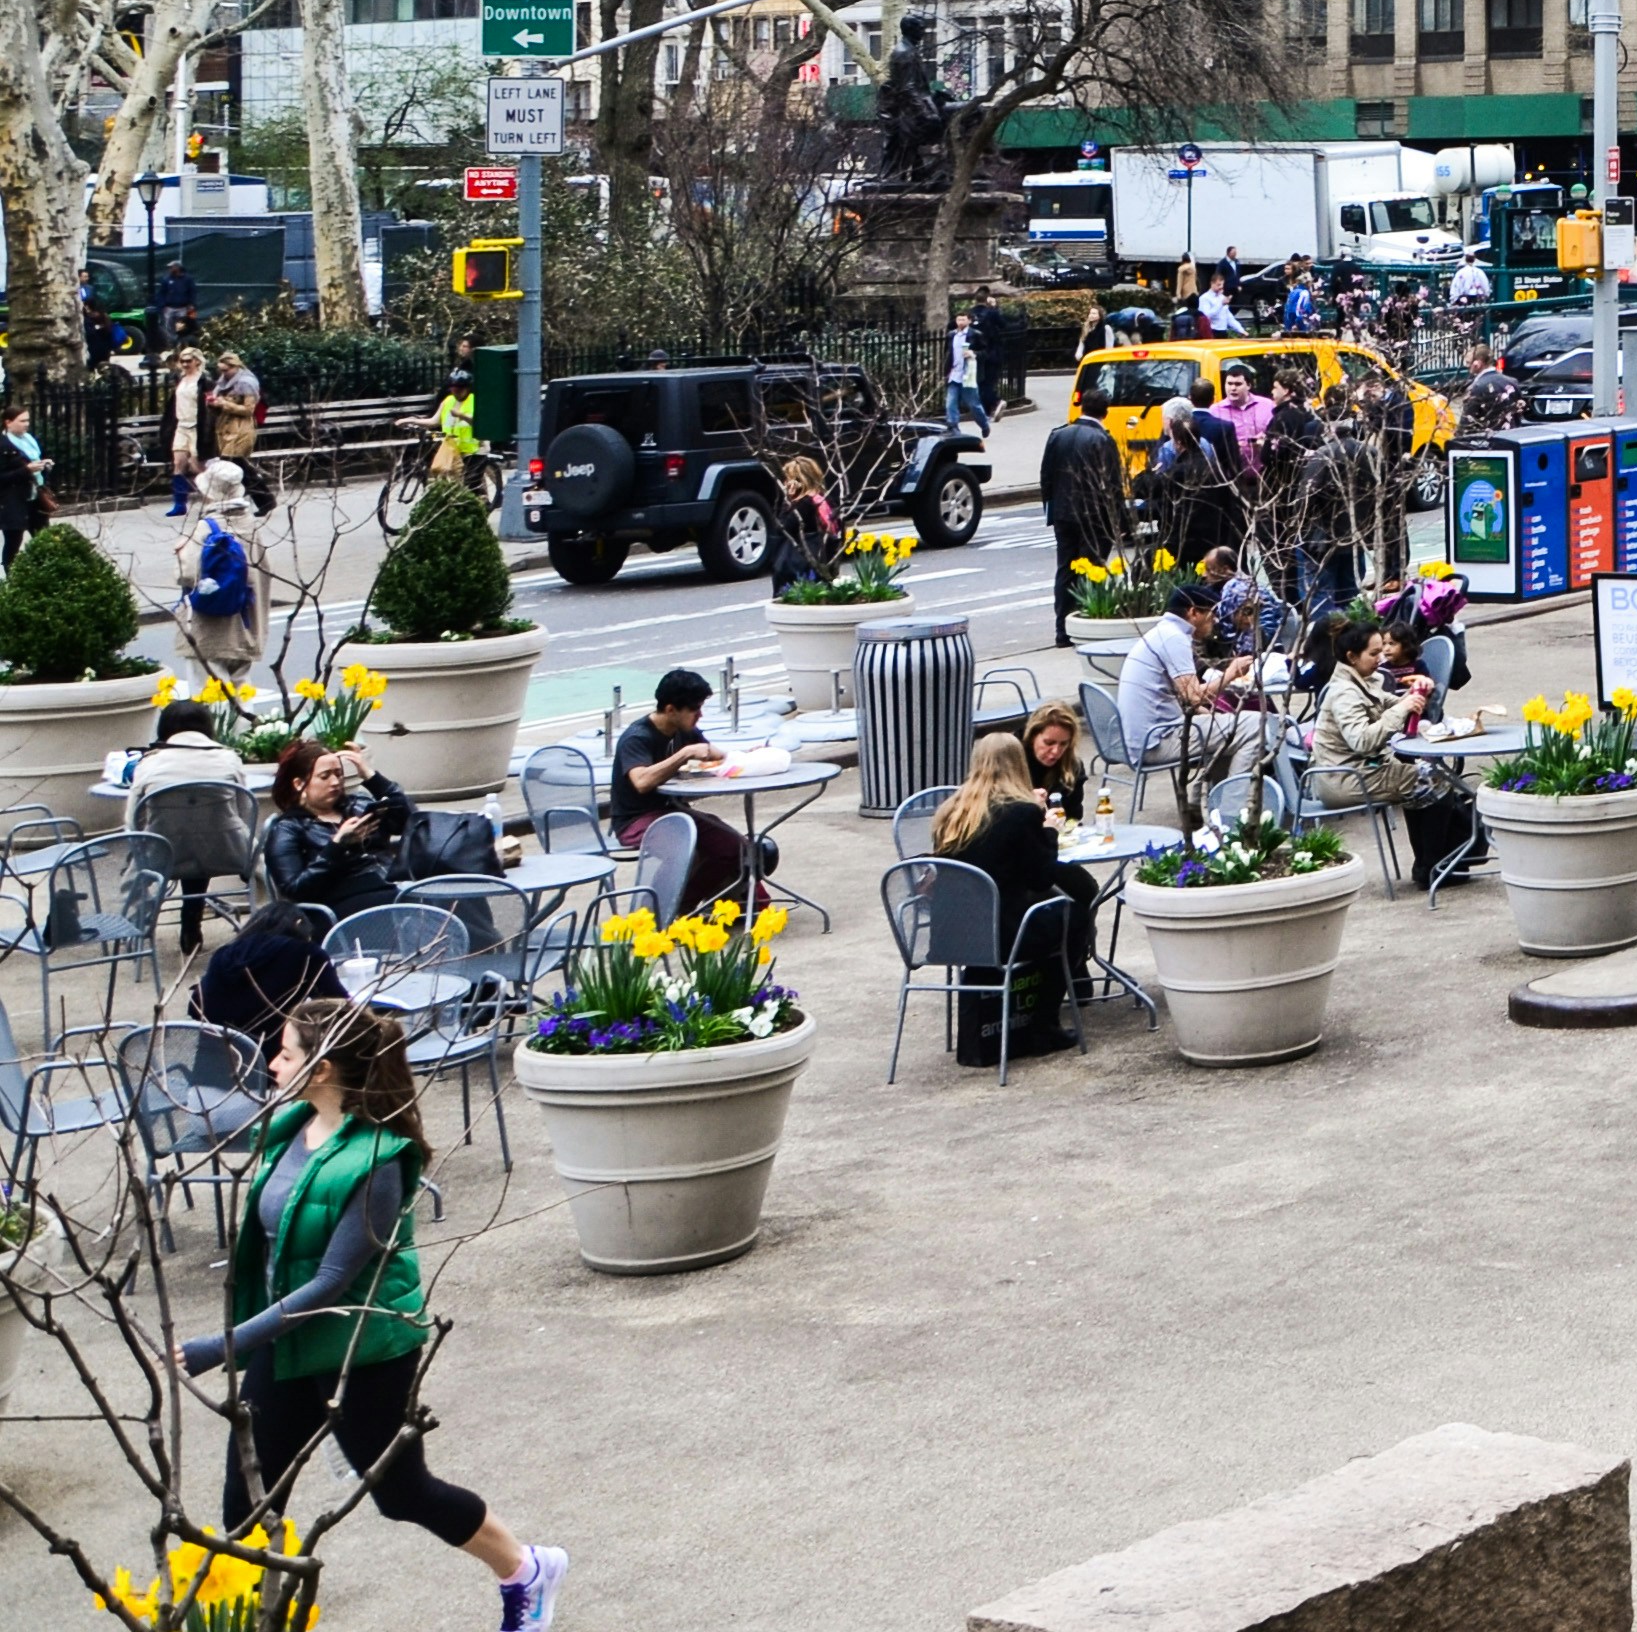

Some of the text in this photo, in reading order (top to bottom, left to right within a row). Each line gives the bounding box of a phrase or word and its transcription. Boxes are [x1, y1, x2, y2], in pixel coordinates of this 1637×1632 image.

[484, 5, 572, 21] Downtown
[494, 88, 557, 100] LEFT LANE
[505, 108, 545, 123] MUST
[494, 132, 557, 144] TURN LEFT
[474, 179, 510, 187] ANYTIME
[563, 463, 595, 478] Jeep
